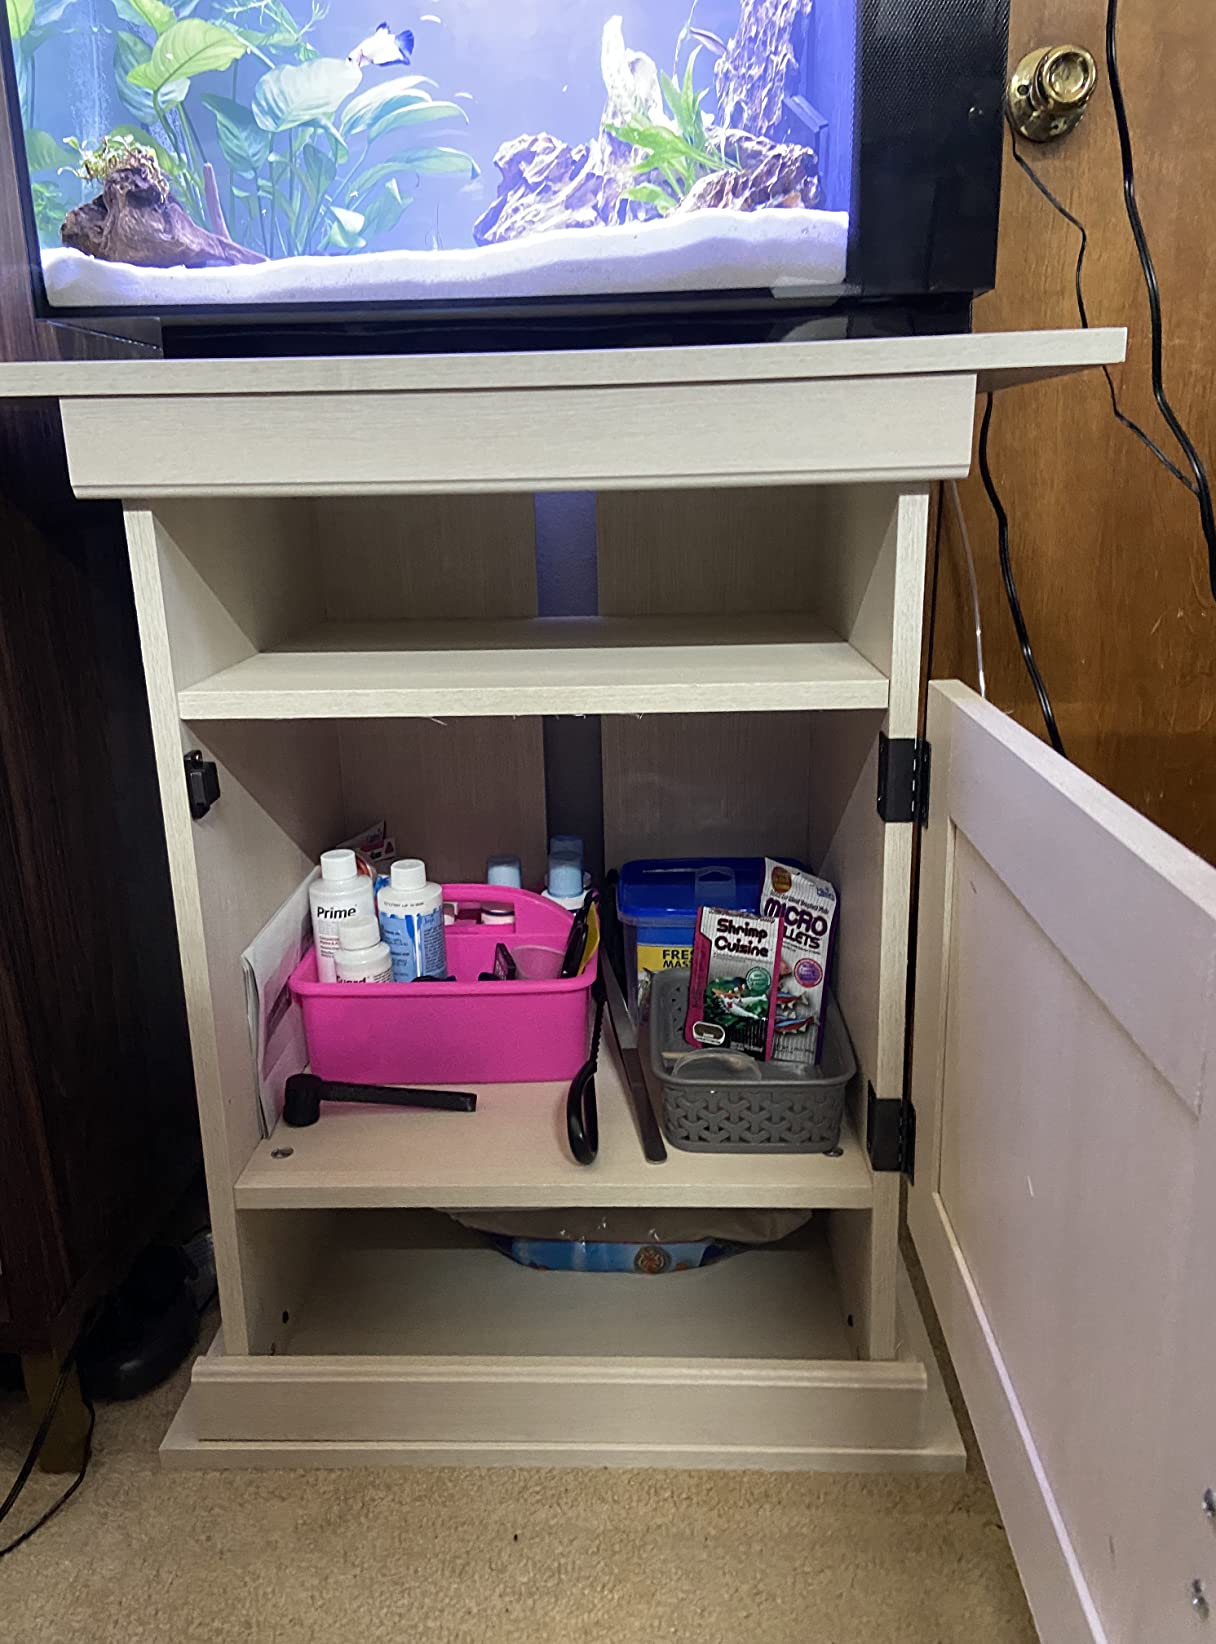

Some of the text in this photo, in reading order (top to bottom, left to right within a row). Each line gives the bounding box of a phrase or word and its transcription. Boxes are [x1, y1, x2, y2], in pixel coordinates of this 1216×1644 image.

[317, 906, 356, 919] Prime
[764, 897, 828, 936] MICRO
[716, 918, 768, 943] Shrimp
[783, 926, 820, 949] LLETS
[715, 935, 769, 957] Cuisine
[662, 960, 692, 969] MAS
